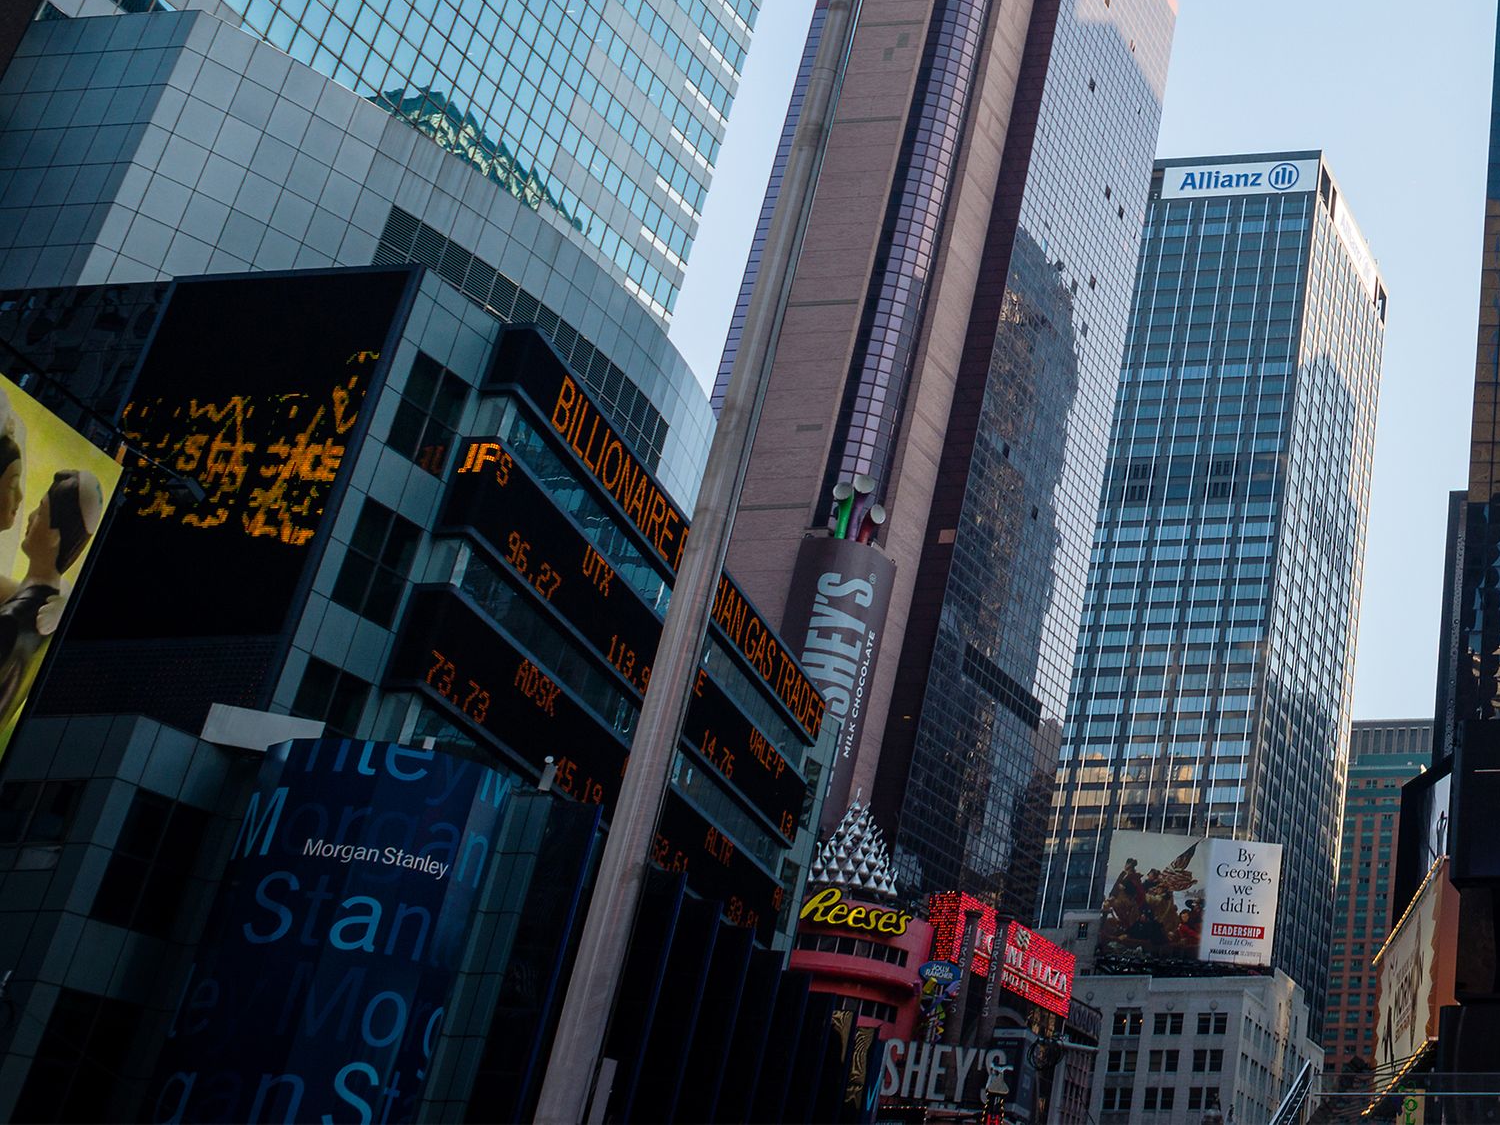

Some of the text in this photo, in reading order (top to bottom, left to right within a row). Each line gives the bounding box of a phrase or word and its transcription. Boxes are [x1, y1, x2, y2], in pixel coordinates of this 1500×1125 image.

[1179, 170, 1263, 191] Allianz
[551, 374, 680, 563] BILLIONAIRE
[743, 616, 777, 682] GAS
[505, 530, 562, 600] 96.27
[606, 634, 651, 695] 113.9
[816, 571, 874, 728] SHEY'S
[424, 649, 492, 724] 73.73
[513, 658, 560, 718] ADSK
[842, 630, 876, 759] MILK CHOCOLATE
[700, 729, 736, 780] 14.76
[302, 837, 449, 881] Morgan Stanley
[1216, 863, 1273, 885] George,
[1238, 848, 1256, 867] By
[800, 887, 912, 936] Reese's
[1220, 897, 1260, 915] did it.
[1233, 883, 1253, 896] we
[1213, 925, 1262, 938] LEADERSHIP
[1219, 938, 1254, 948] Pass It On.
